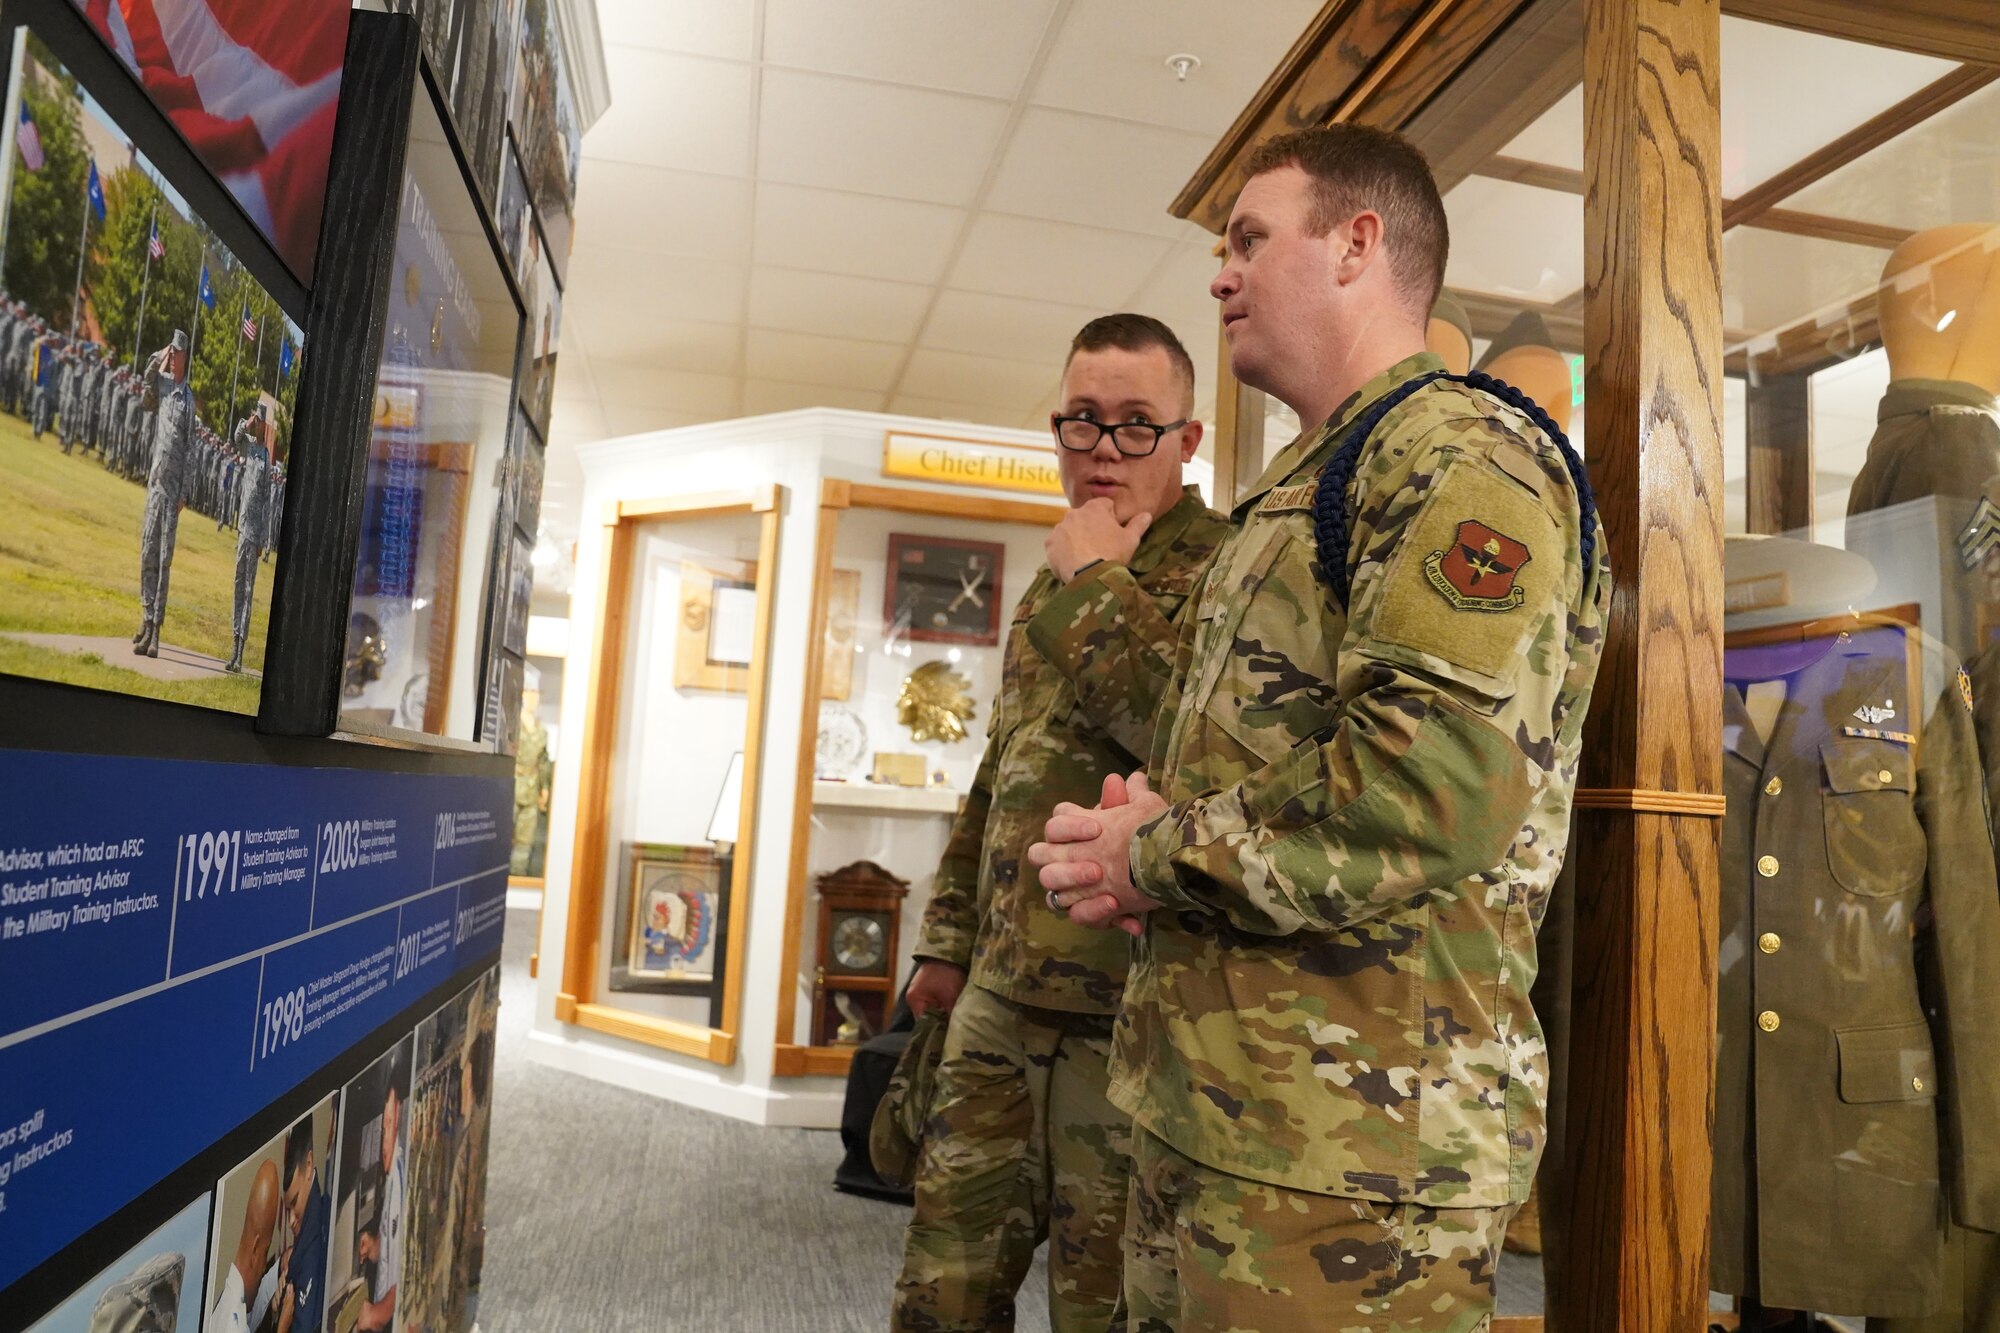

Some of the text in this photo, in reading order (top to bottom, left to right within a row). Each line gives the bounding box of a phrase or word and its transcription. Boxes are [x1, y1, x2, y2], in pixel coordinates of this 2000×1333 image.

[920, 448, 1059, 484] Chief Histo
[47, 844, 80, 866] which
[82, 841, 104, 863] had
[105, 844, 118, 860] an
[120, 838, 144, 858] AFSC
[245, 826, 299, 844] Name changed from
[320, 819, 359, 874] 2003
[185, 830, 240, 901] 1991
[243, 845, 308, 867] Student Training Advisor to
[1, 869, 130, 906] Student Training Advisor
[240, 873, 262, 890] Military
[263, 870, 283, 885] Training
[3, 892, 159, 939] the Military Training Instructors.
[397, 931, 421, 979] 2011
[308, 979, 320, 995] Chief
[261, 986, 305, 1059] 1998
[12, 1129, 73, 1173] Instructors
